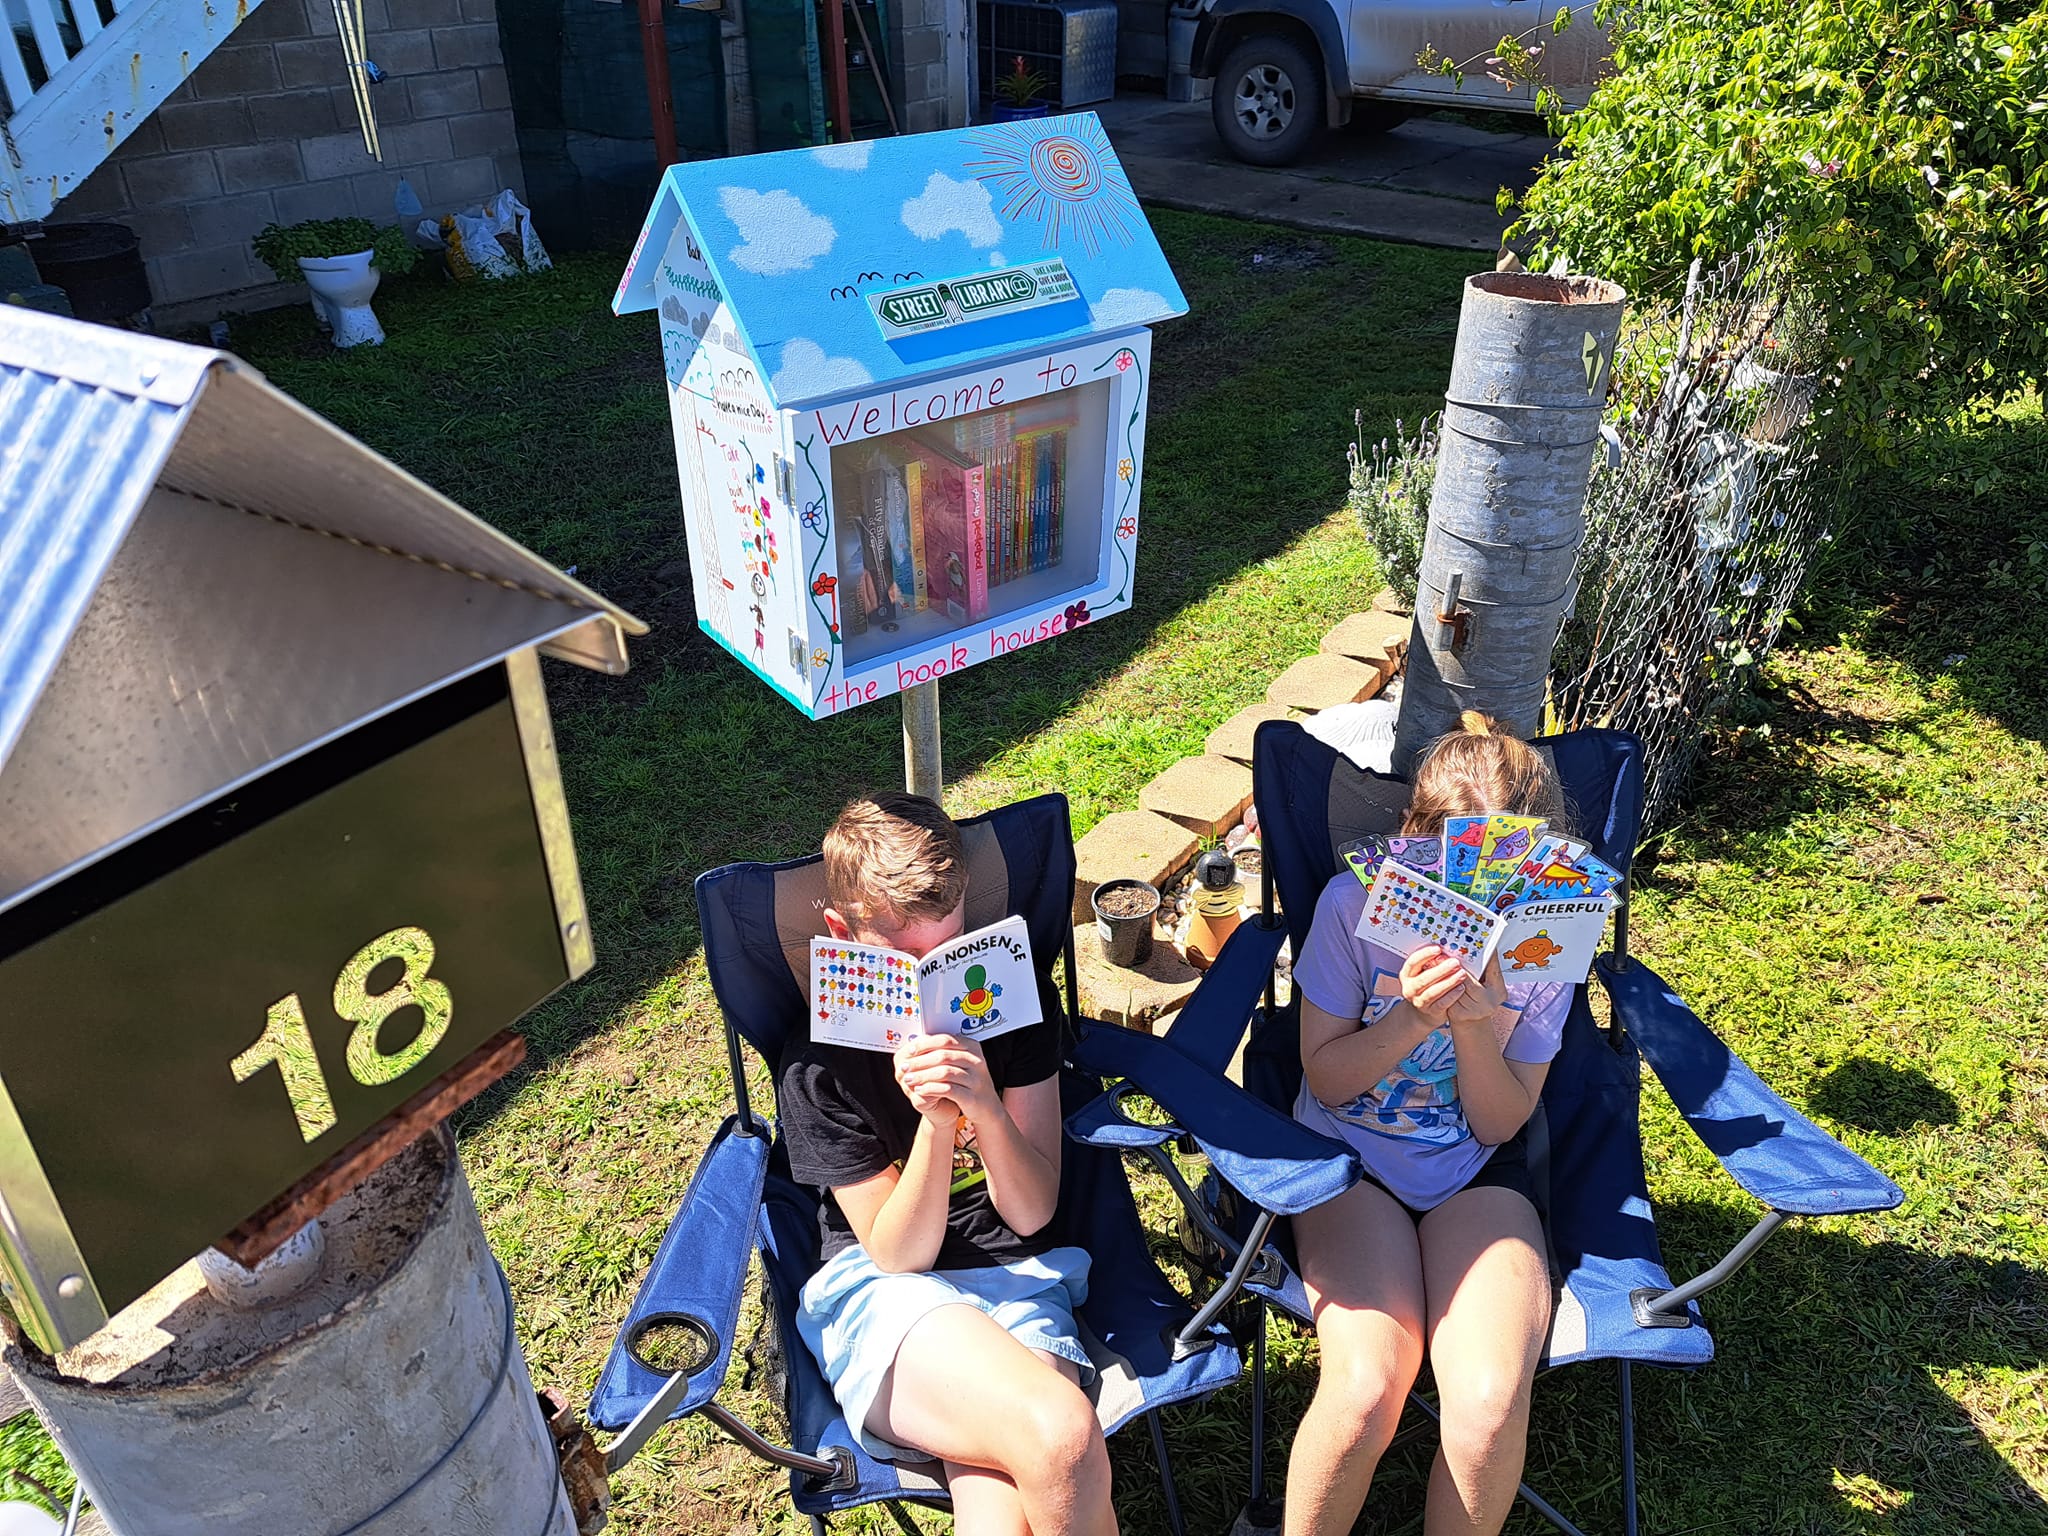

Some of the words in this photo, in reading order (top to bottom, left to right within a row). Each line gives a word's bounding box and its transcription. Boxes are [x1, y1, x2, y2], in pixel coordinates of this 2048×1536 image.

[1033, 266, 1047, 276] TAKE
[1038, 276, 1051, 285] GIVE
[888, 293, 940, 321] STREET
[954, 275, 1014, 307] LIBRARY
[750, 403, 765, 424] Day
[815, 377, 1005, 445] Welcome
[1037, 357, 1078, 393] to
[875, 497, 885, 525] Fifty
[876, 525, 887, 561] Shades
[823, 680, 878, 712] the
[896, 641, 968, 691] book
[990, 613, 1063, 657] house
[1524, 902, 1606, 916] CHEERFUL
[920, 960, 942, 982] MR.
[944, 935, 1027, 965] NONSENSE
[228, 925, 455, 1144] 18
